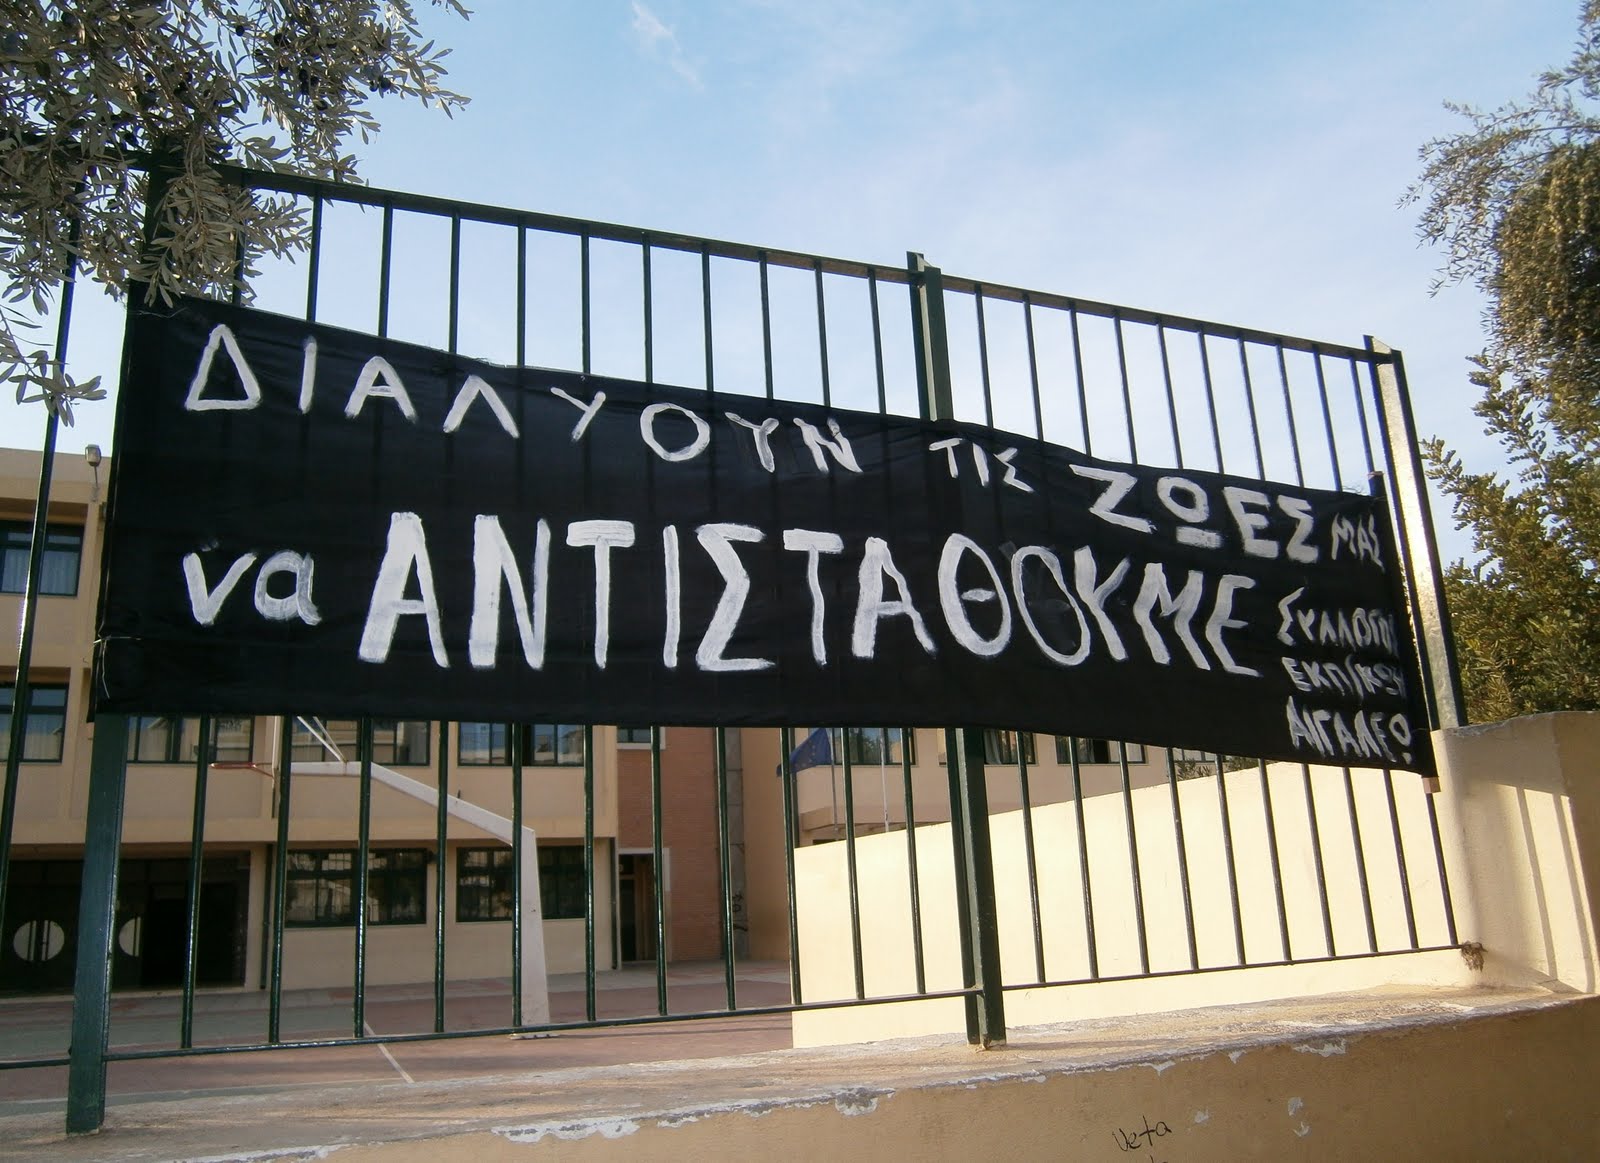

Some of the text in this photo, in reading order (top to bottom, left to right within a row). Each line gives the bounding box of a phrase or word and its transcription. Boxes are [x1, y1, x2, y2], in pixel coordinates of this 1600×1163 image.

[185, 323, 1385, 573] ΔΙΑΛΥΟΥΝ ΤΙΣ ΖΩΕΣ ΜΑΣ
[357, 511, 1261, 679] ΑΝΤΙΣΤΑΘΟΥΜΕ
